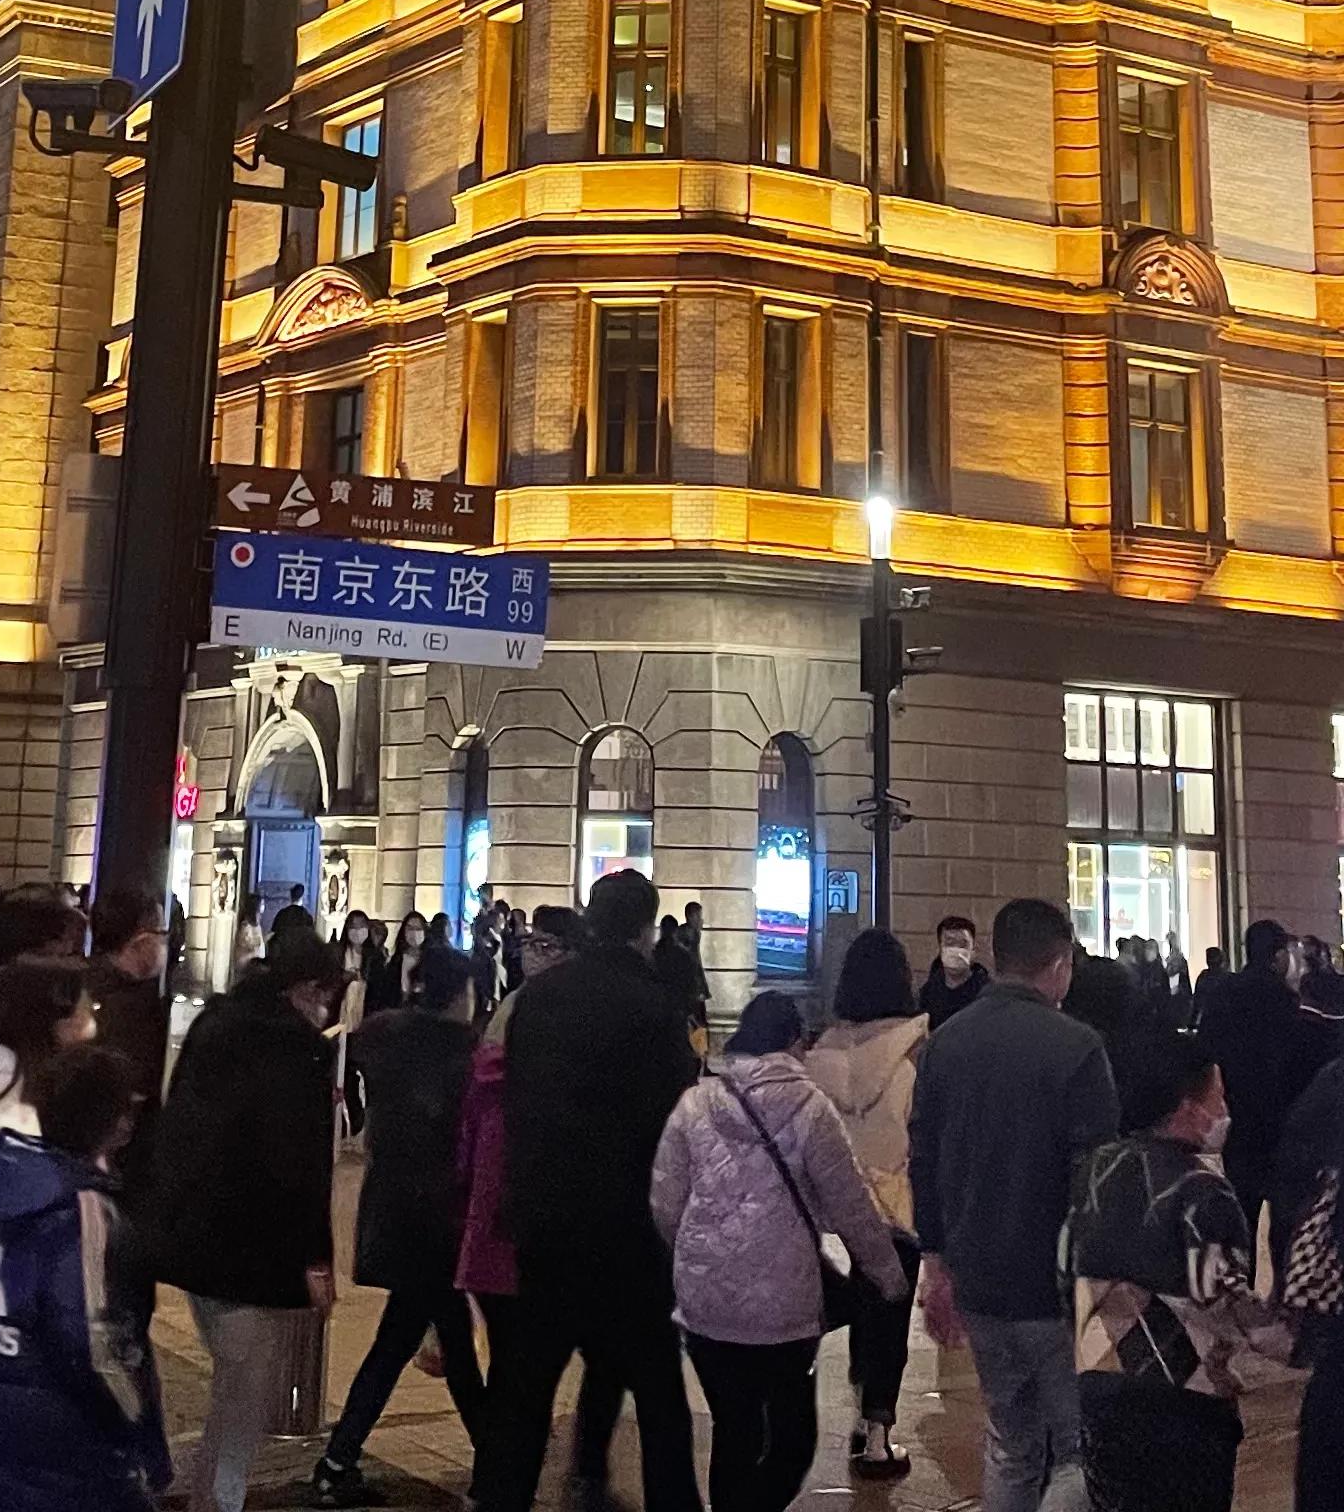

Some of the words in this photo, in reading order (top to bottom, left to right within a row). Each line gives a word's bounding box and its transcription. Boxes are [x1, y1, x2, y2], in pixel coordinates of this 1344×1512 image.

[329, 479, 475, 515] 黄浦滨江
[350, 514, 400, 535] Huangpu
[403, 518, 454, 537] Riverside
[276, 548, 491, 619] 南京东路
[511, 567, 534, 596] 西
[507, 599, 534, 624] 99
[224, 615, 241, 638] E
[286, 619, 363, 648] Nanjing
[377, 627, 409, 649] Rd.
[422, 634, 449, 653] (E)
[506, 639, 527, 661] W
